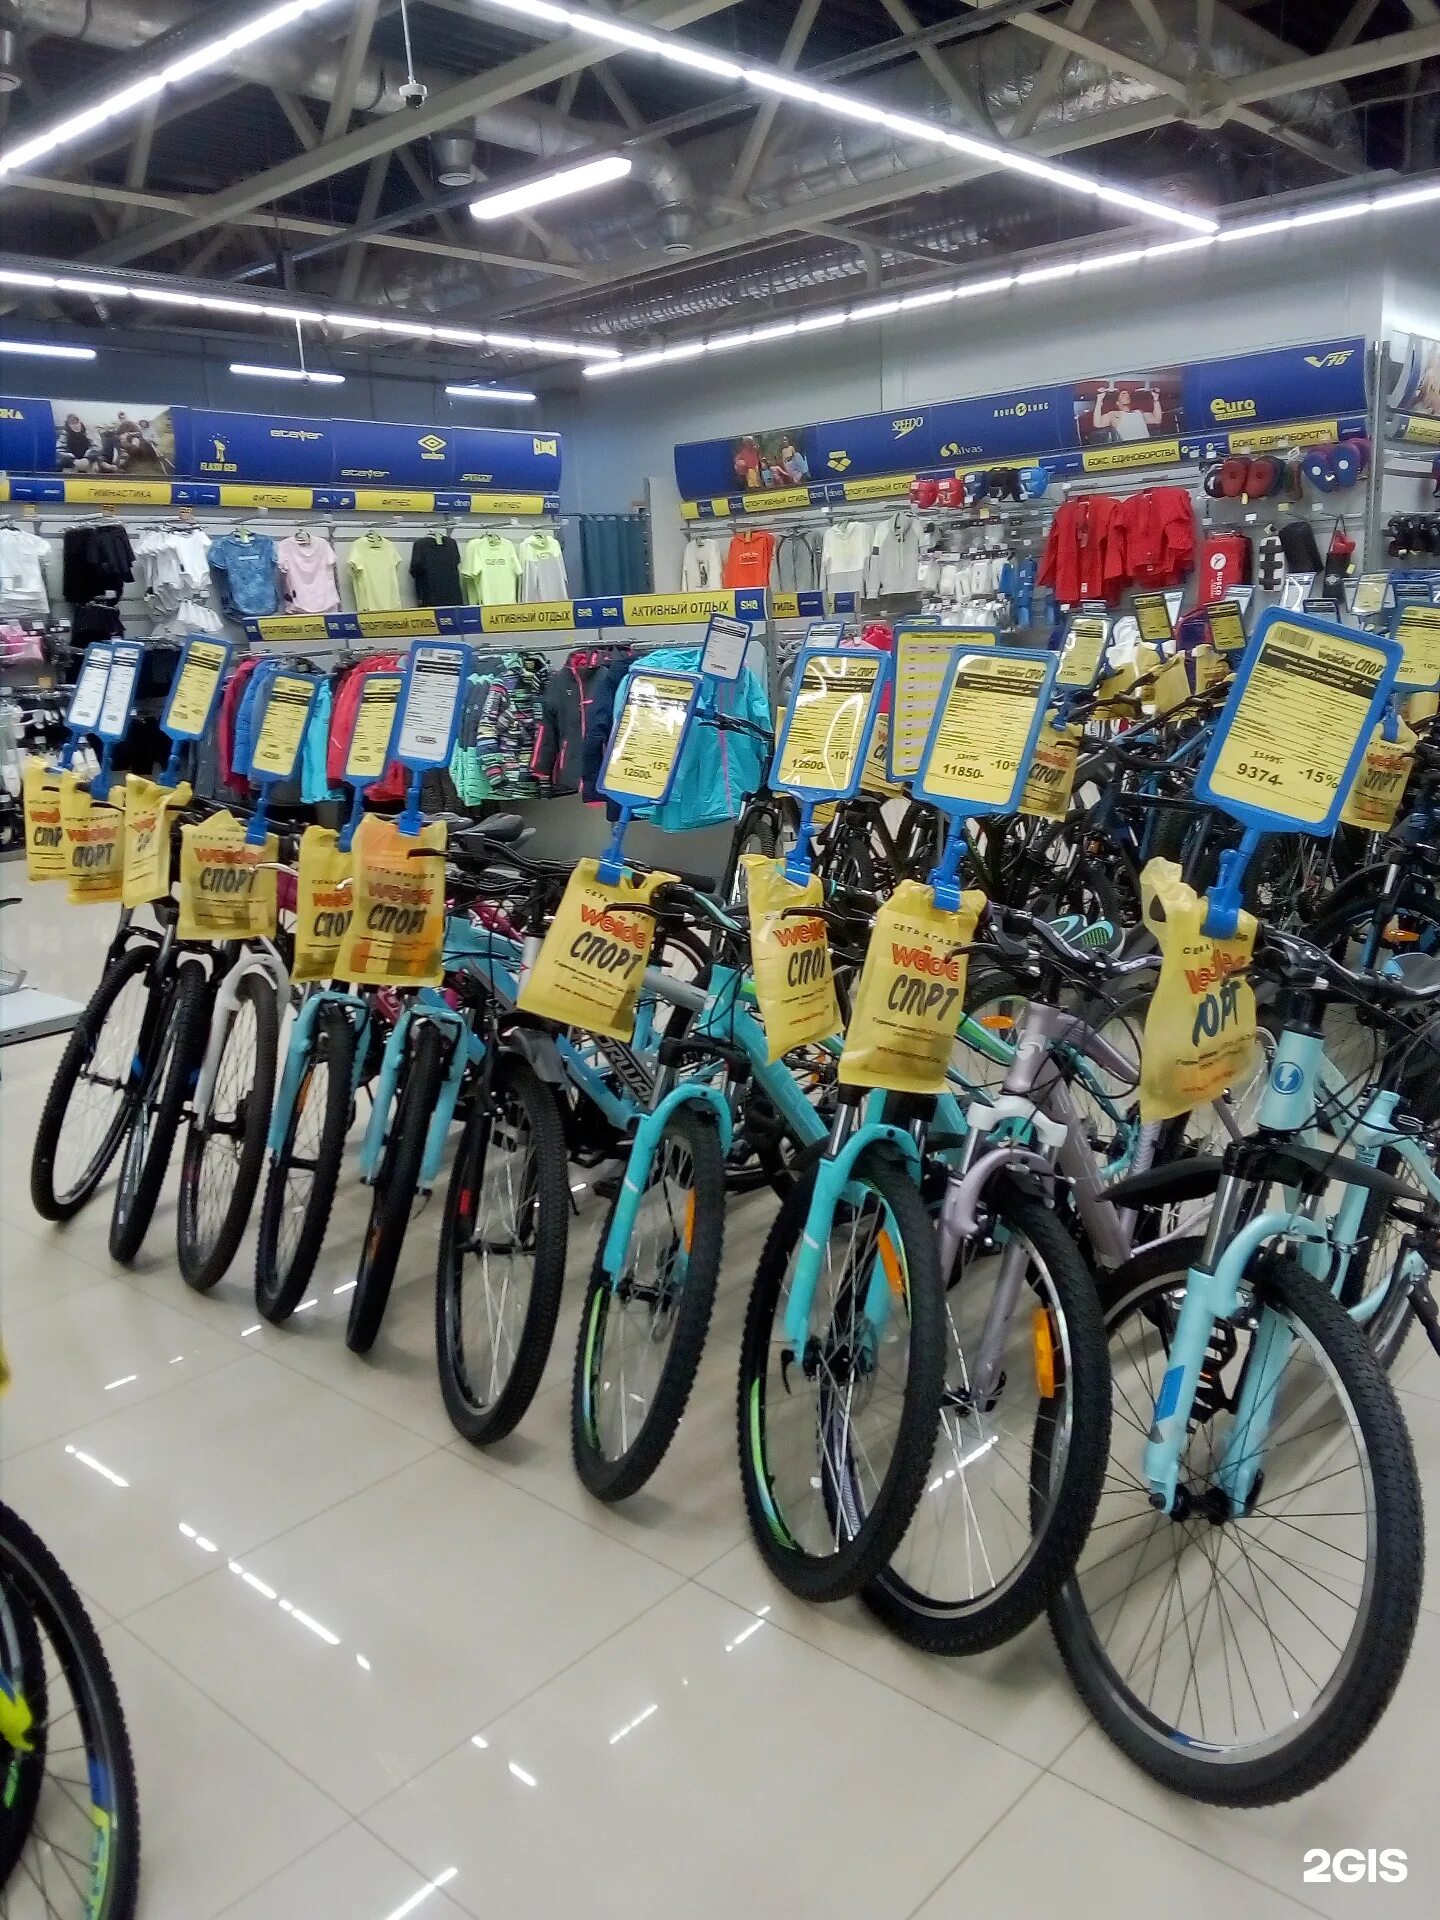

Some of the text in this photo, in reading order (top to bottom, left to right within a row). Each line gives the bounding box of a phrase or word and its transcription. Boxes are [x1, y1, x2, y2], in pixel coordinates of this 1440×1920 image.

[489, 608, 572, 626] АКТИВНЫЙ ОТДЫХ
[631, 598, 730, 618] АКТИВНЫЙ ОТДЫХ
[943, 763, 985, 780] 11850-
[1236, 762, 1284, 786] 9374-
[1298, 768, 1340, 789] -15%
[569, 930, 643, 981] СПОРТ
